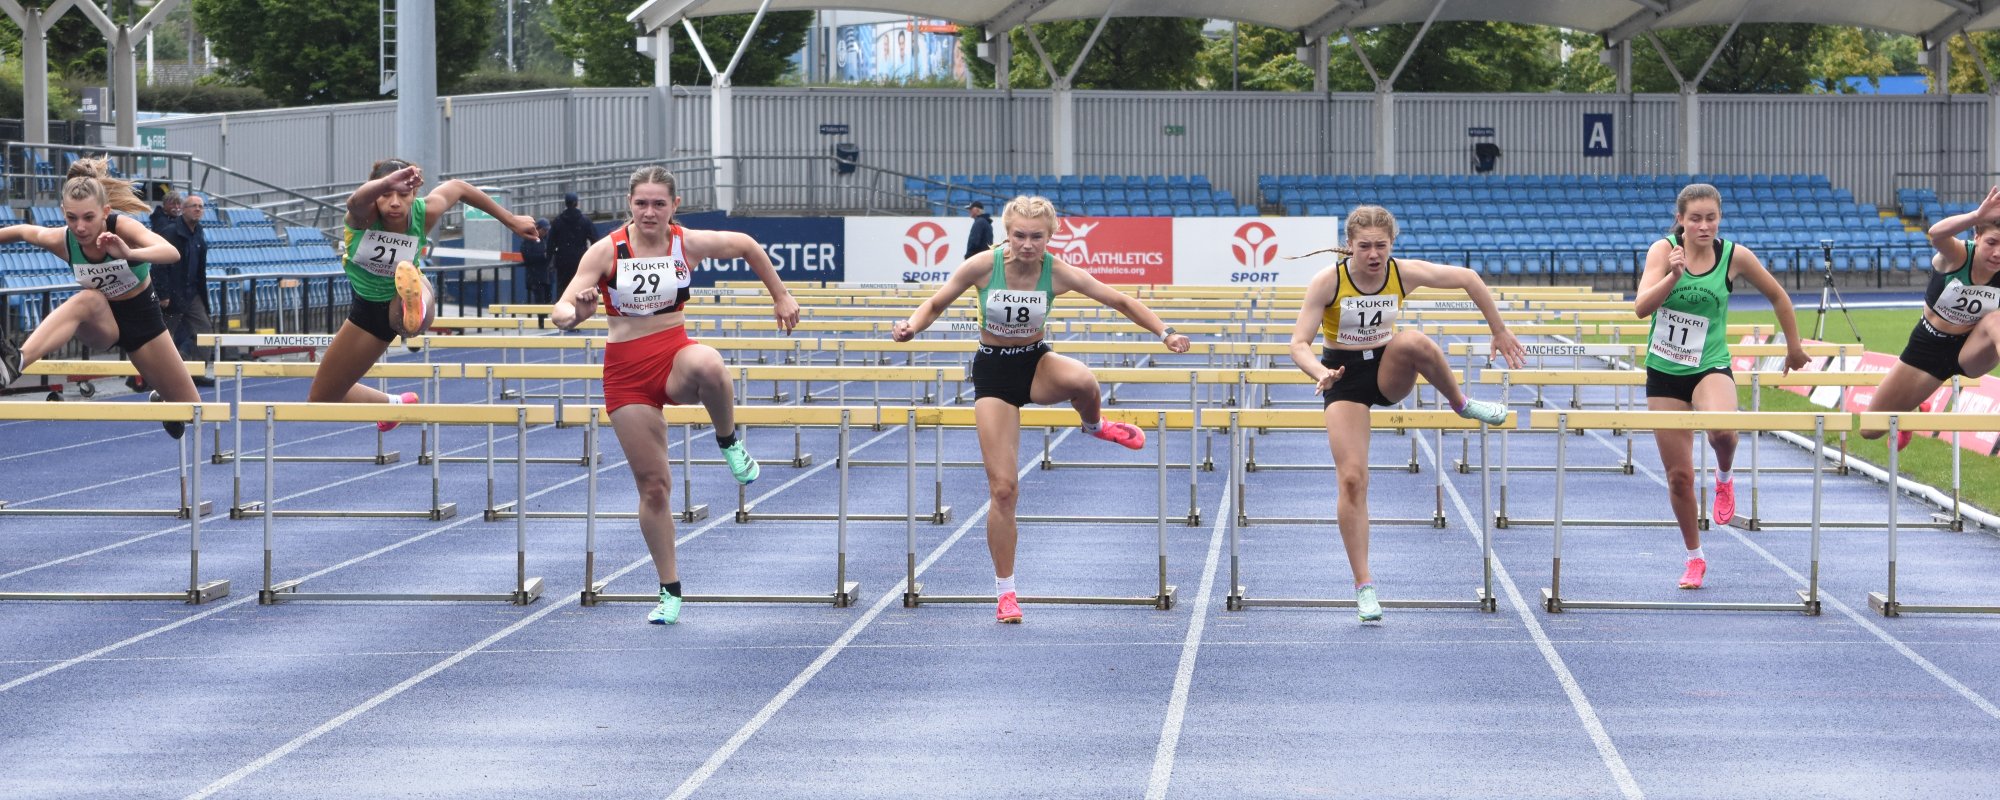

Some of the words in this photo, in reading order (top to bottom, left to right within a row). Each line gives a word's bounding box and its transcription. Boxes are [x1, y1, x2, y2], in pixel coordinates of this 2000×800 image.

[1588, 121, 1608, 149] A
[378, 234, 413, 248] KUKRI
[369, 245, 397, 265] 21
[1091, 252, 1163, 265] ATHLETICS
[87, 264, 124, 275] KUKRI
[632, 262, 669, 271] KUKRI
[91, 274, 118, 289] 22
[902, 271, 950, 282] SPORT
[1230, 272, 1279, 283] SPORT
[632, 273, 661, 295] 29
[633, 294, 662, 303] ELLIOTT
[1003, 294, 1041, 304] KUKRI
[1960, 288, 1996, 300] KUKRI
[622, 299, 673, 311] MANCHESTER
[1356, 300, 1393, 309] KUKRI
[1950, 297, 1983, 315] 20
[1004, 306, 1030, 323] 18
[1357, 310, 1383, 328] 14
[1668, 313, 1704, 328] KUKRI
[1340, 331, 1390, 342] MANCHESTER
[1668, 324, 1689, 346] 11
[1000, 343, 1035, 355] NIKE
[1525, 345, 1586, 355] ANCHESTER
[1652, 343, 1698, 363] MANCHESTER
[1660, 340, 1692, 354] CHRISTIAN
